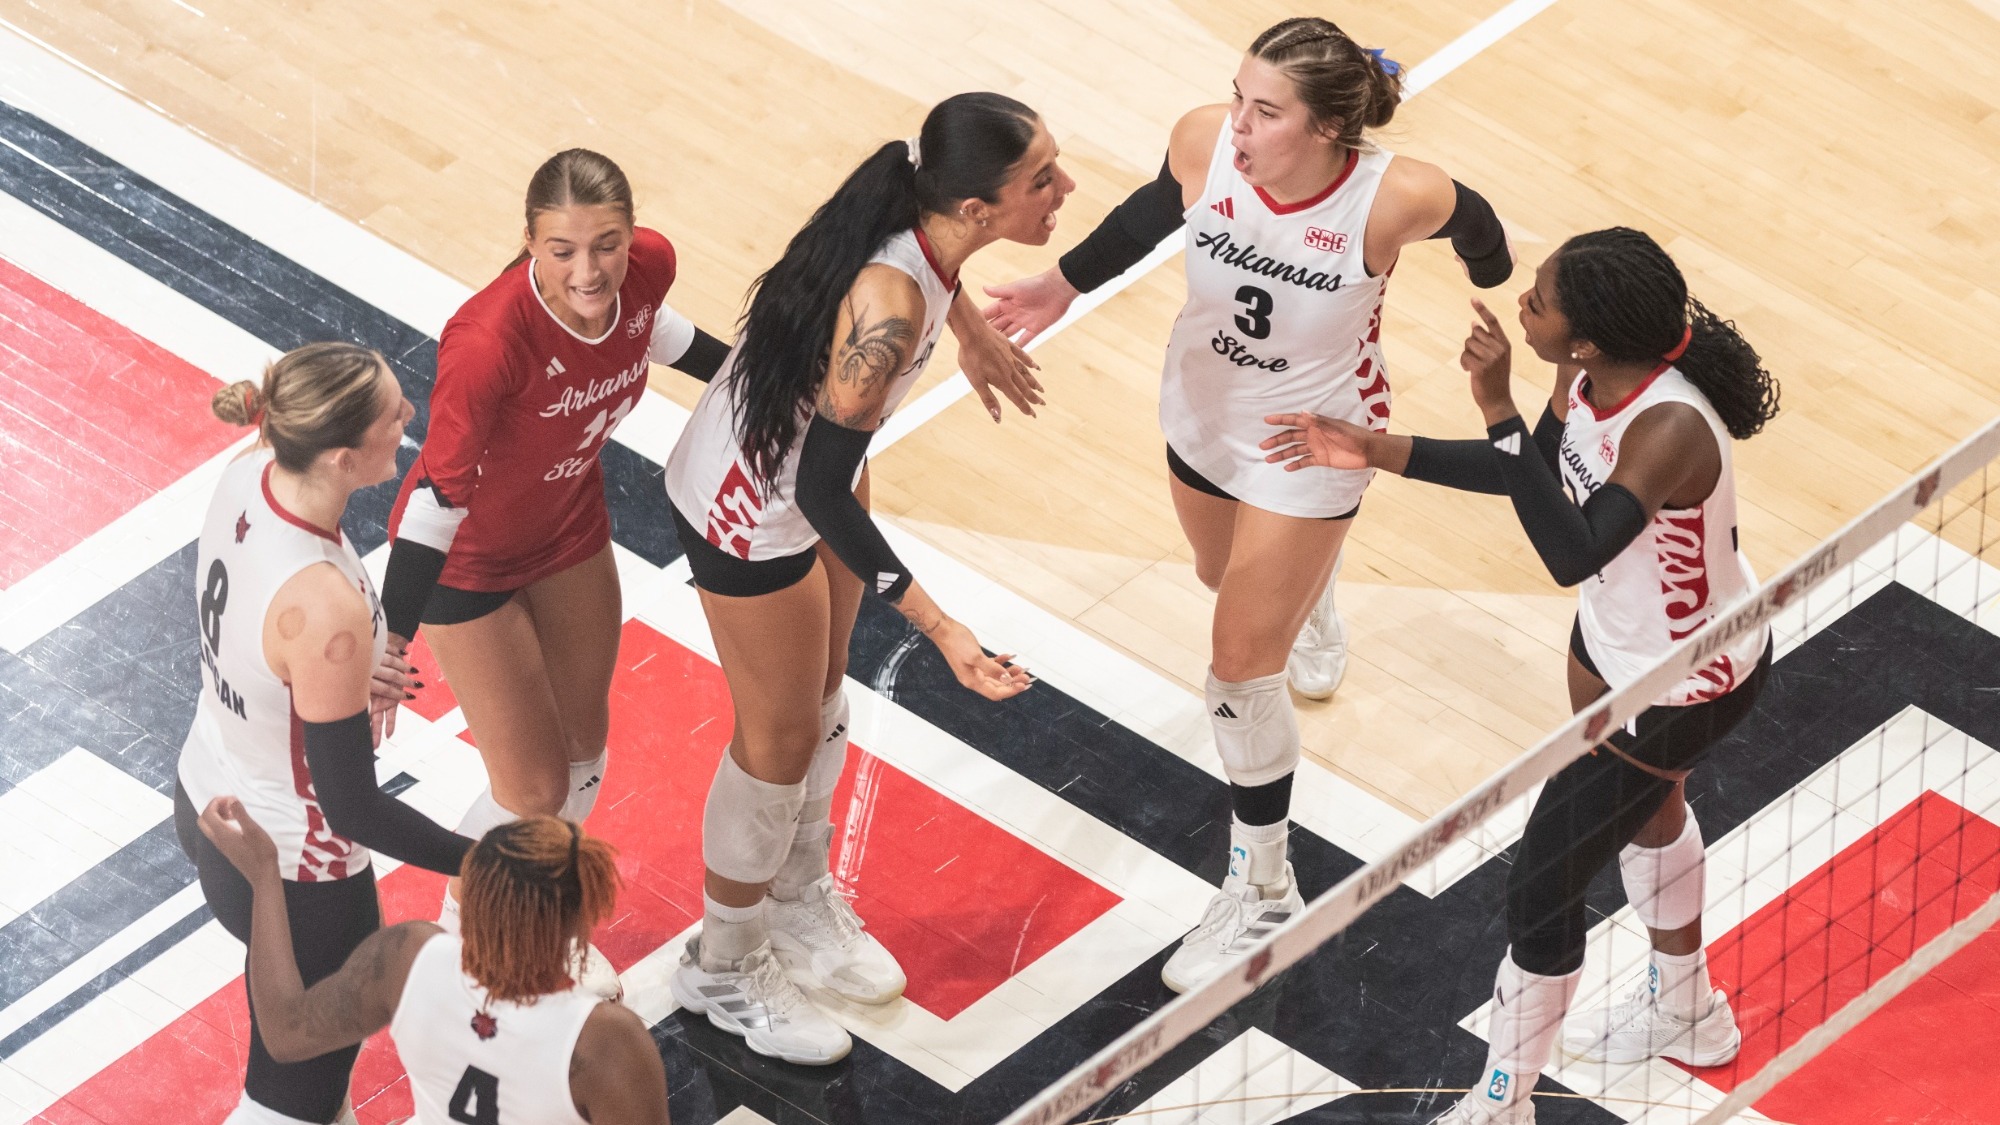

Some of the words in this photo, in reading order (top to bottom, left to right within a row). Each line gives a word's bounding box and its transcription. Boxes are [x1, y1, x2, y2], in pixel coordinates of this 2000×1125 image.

[1195, 231, 1346, 293] Arkansas
[1304, 226, 1349, 254] SBC
[1233, 284, 1274, 341] 3
[200, 558, 230, 658] 8
[447, 1064, 501, 1125] 4
